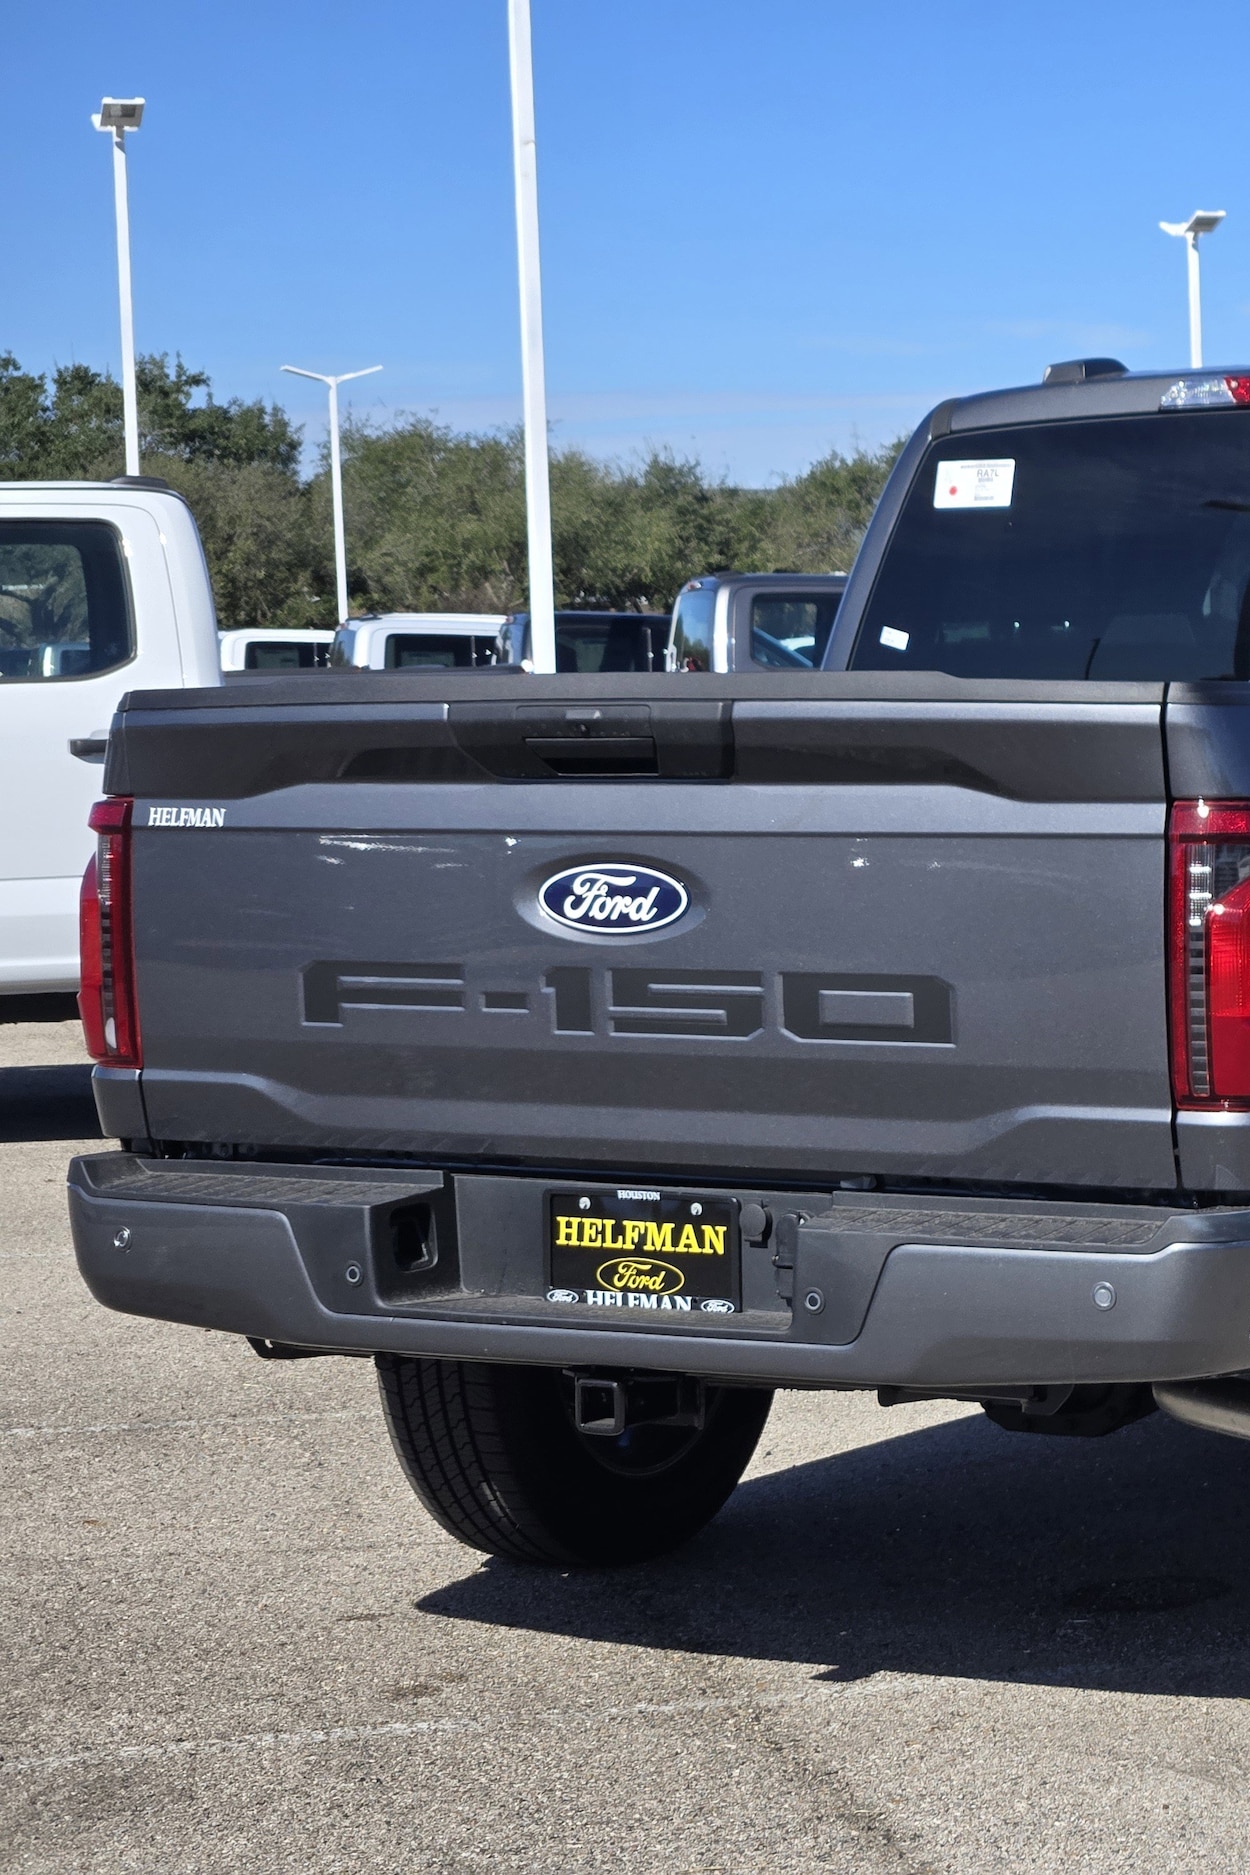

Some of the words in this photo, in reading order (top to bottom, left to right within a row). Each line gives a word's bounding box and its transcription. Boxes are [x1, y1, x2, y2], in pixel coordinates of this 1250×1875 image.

[147, 806, 227, 828] HELFMAN
[561, 870, 661, 923] Ford
[300, 958, 958, 1048] F-150
[616, 1189, 661, 1202] HOUSTON
[554, 1215, 728, 1256] HELFMAN
[612, 1260, 667, 1291] Ford
[585, 1289, 693, 1312] HELFMAN
